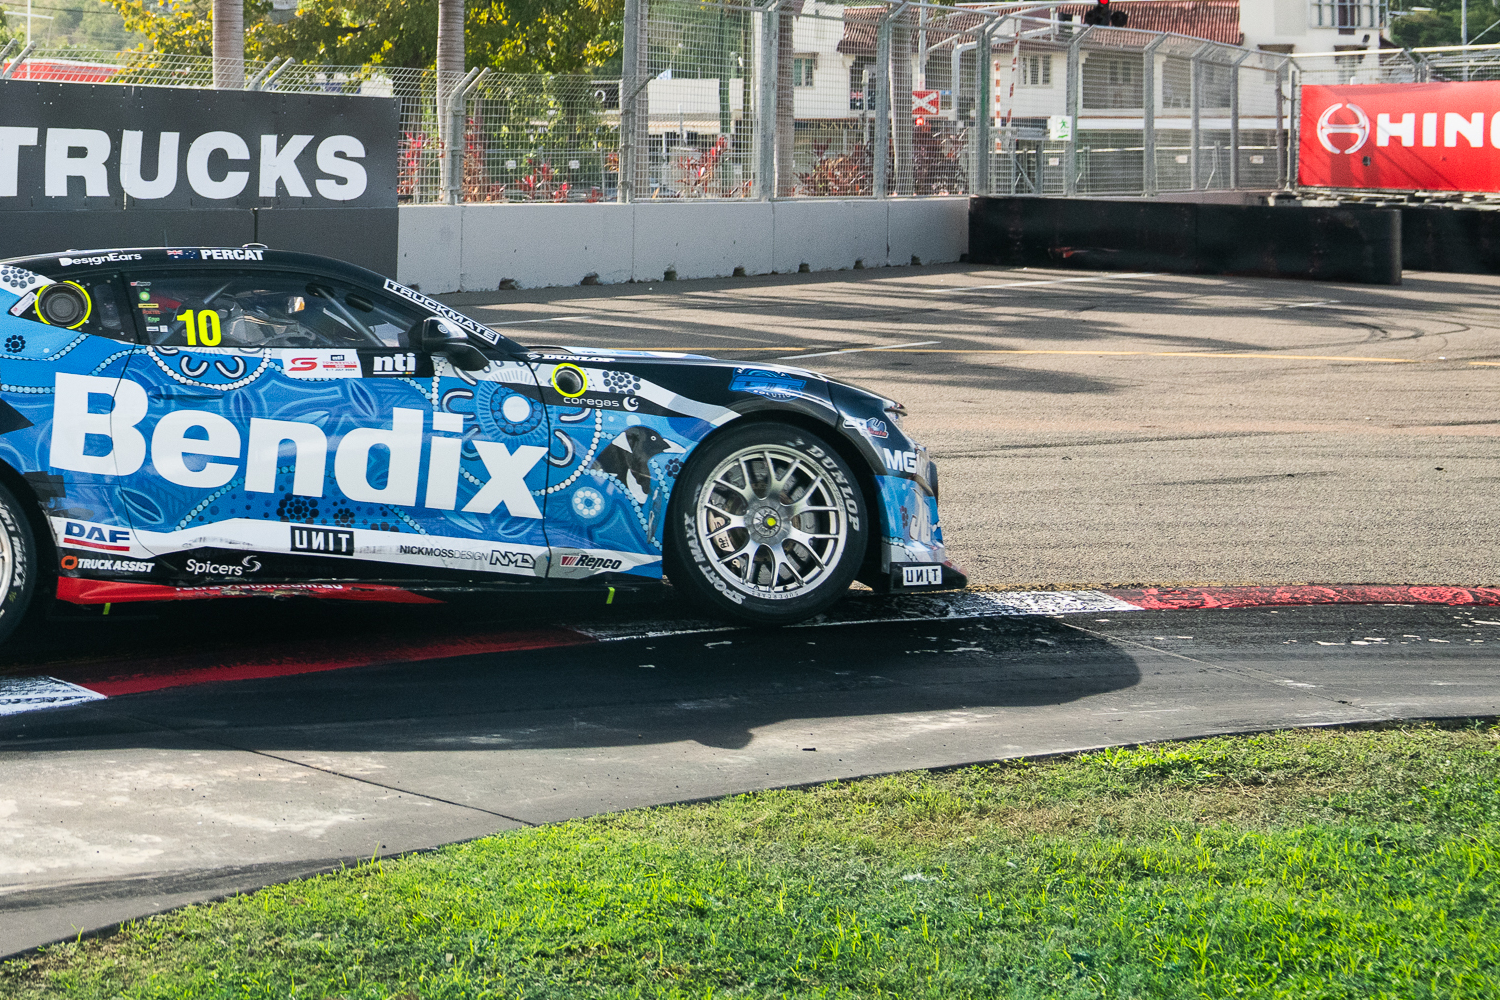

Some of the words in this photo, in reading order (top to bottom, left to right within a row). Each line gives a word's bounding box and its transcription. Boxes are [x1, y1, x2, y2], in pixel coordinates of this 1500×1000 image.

[1377, 112, 1500, 149] HIN
[58, 253, 142, 266] DesignEars
[201, 249, 264, 261] PERCAT
[389, 281, 497, 340] TRUCKMATE
[177, 309, 222, 347] 10
[373, 352, 416, 371] nti
[542, 354, 616, 362] DUNLOP
[563, 397, 620, 407] coregas
[49, 371, 549, 520] Bendix
[806, 445, 860, 531] DUNLOP
[65, 521, 130, 543] DAF
[294, 529, 351, 553] UNIT
[185, 558, 243, 576] Spicers
[575, 554, 622, 570] Repco
